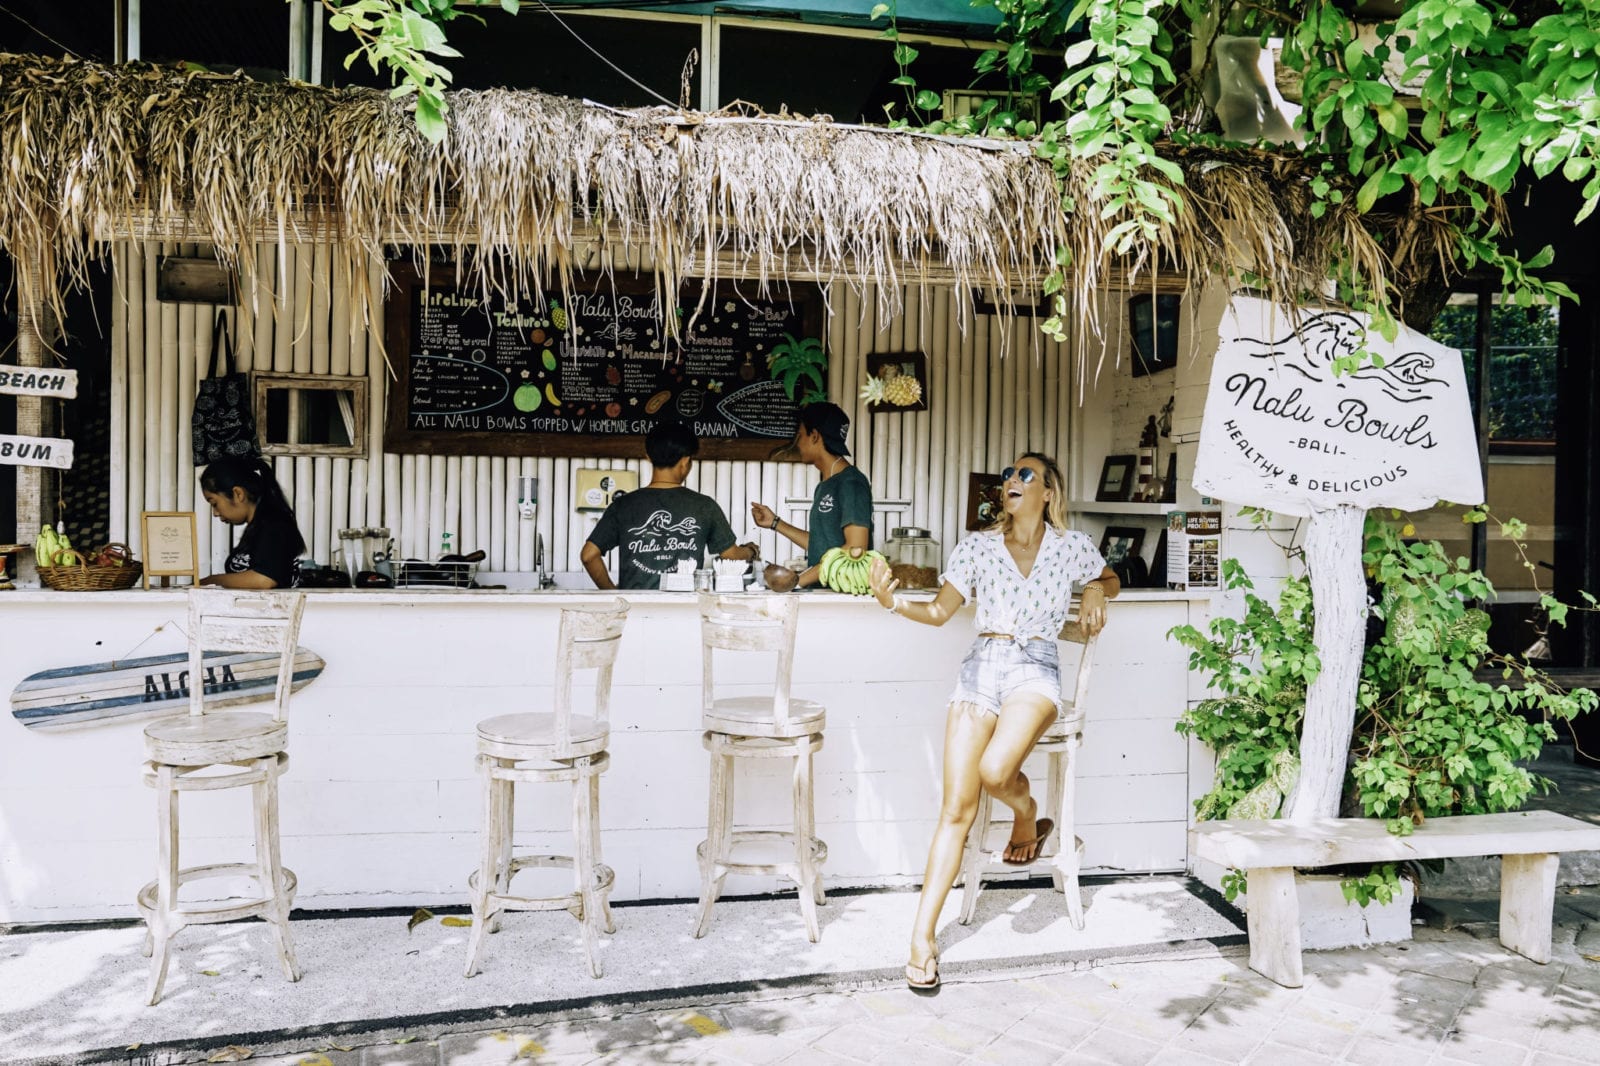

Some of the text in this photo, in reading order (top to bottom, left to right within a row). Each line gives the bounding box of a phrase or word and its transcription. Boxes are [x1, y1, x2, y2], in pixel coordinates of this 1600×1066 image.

[570, 295, 611, 317] Nalu
[0, 371, 66, 390] BEACH
[1225, 373, 1438, 450] Nalu Bowls
[414, 413, 437, 428] ALL
[444, 413, 480, 429] NALU
[486, 416, 526, 430] BOWLS
[531, 417, 569, 432] TOPPED
[571, 418, 587, 433] W/
[589, 419, 629, 434] HOMEMADE
[694, 421, 739, 438] BANANA
[1, 441, 52, 461] BUM
[1223, 420, 1408, 493] HEALTHY & DELICIOUS
[628, 537, 698, 554] Nalu Bowls
